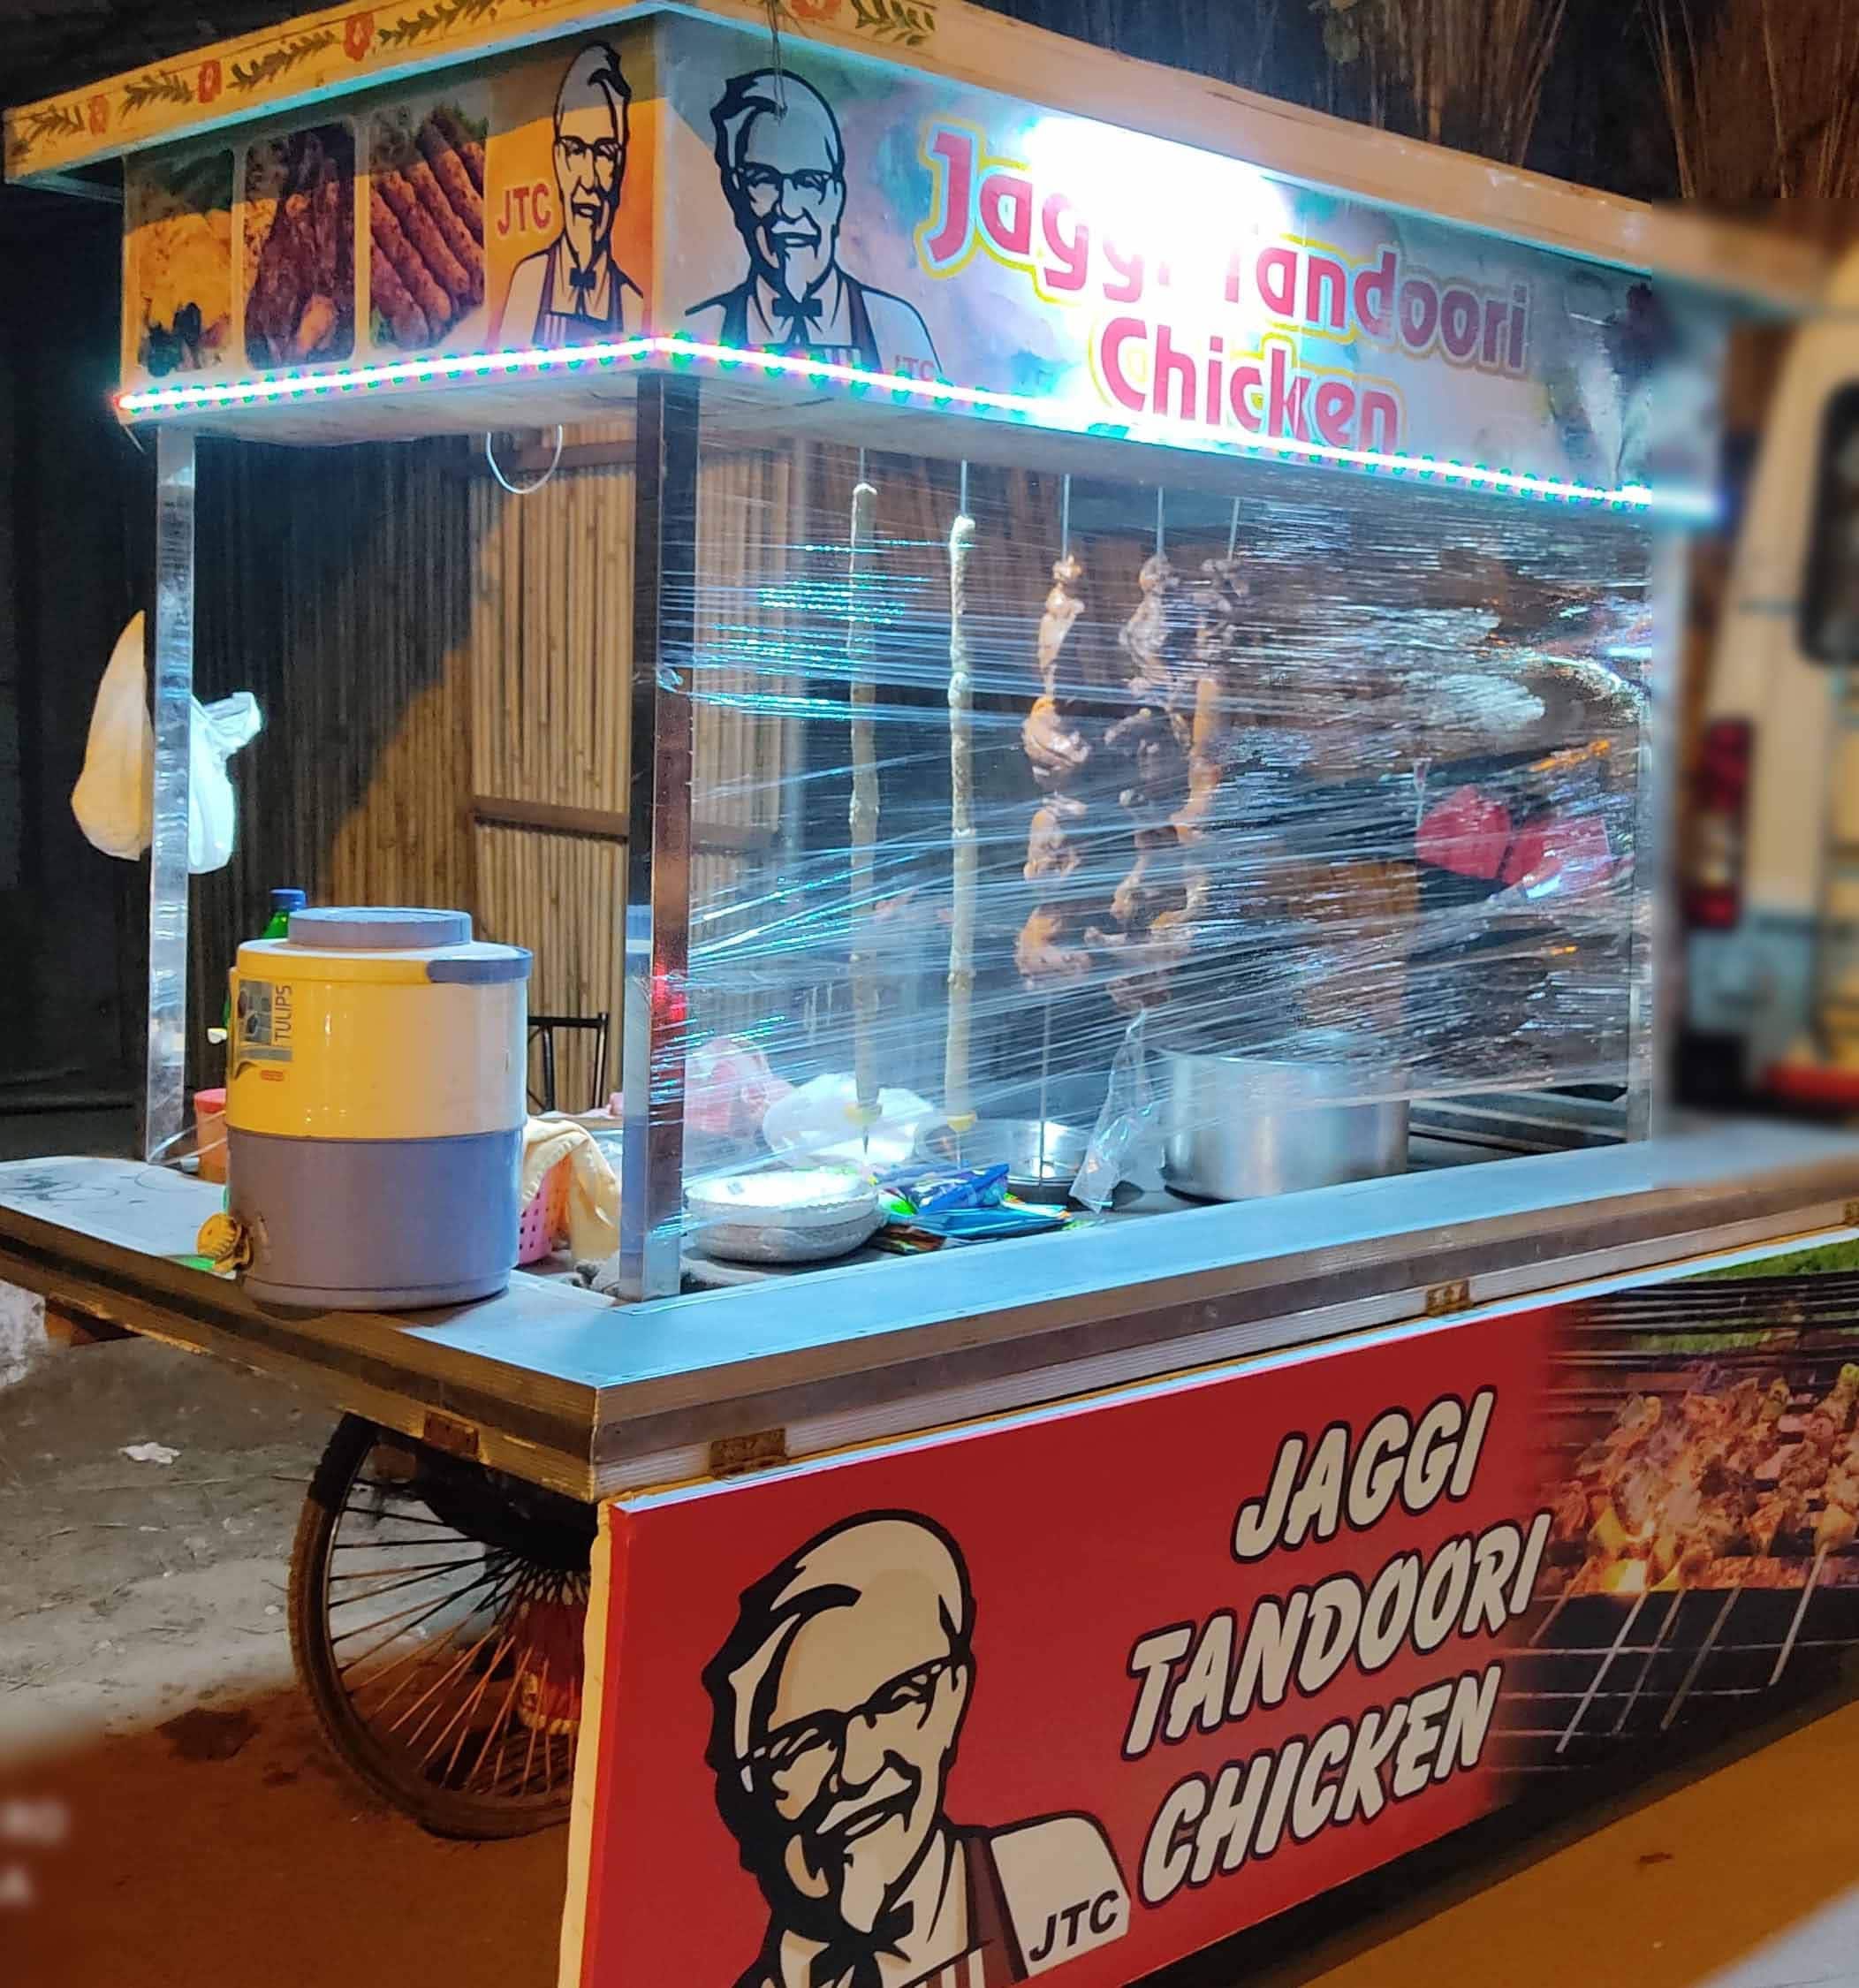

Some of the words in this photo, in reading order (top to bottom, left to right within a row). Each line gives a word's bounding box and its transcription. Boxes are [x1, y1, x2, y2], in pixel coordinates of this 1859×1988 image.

[497, 182, 552, 237] JTC
[927, 131, 1172, 304] Jagg
[1100, 316, 1398, 451] Chicken
[275, 984, 293, 1042] TULIPS
[1232, 1386, 1496, 1562] JAGGI
[1122, 1510, 1553, 1759] TANDOORI
[1141, 1663, 1505, 1907] CHICKEN
[1028, 1889, 1120, 1961] JTC
